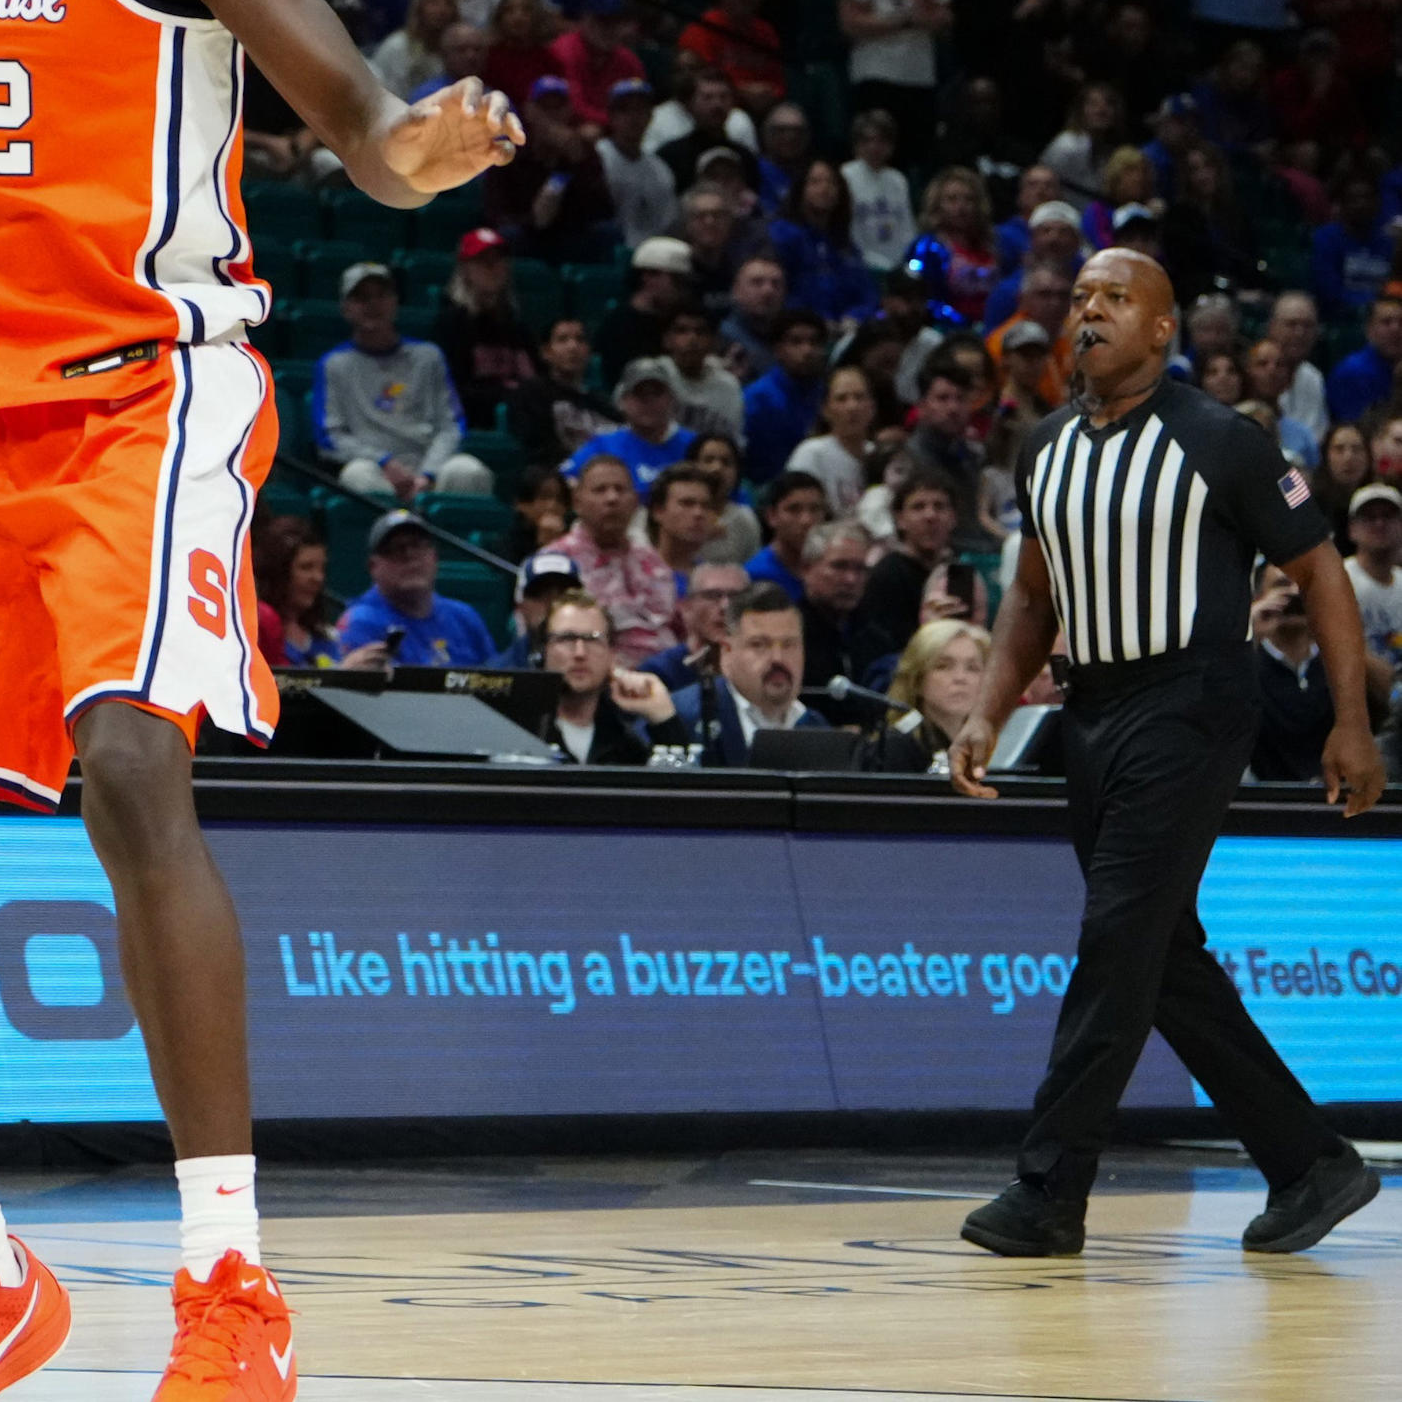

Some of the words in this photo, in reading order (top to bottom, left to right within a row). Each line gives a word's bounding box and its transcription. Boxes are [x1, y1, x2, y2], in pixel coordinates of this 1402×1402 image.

[187, 547, 228, 640] S
[278, 931, 392, 997] Like
[397, 931, 577, 1015] hitting
[582, 950, 616, 997] a
[619, 932, 972, 998] buzzer-beater
[981, 952, 1080, 1015] goo
[1246, 947, 1343, 997] Feels
